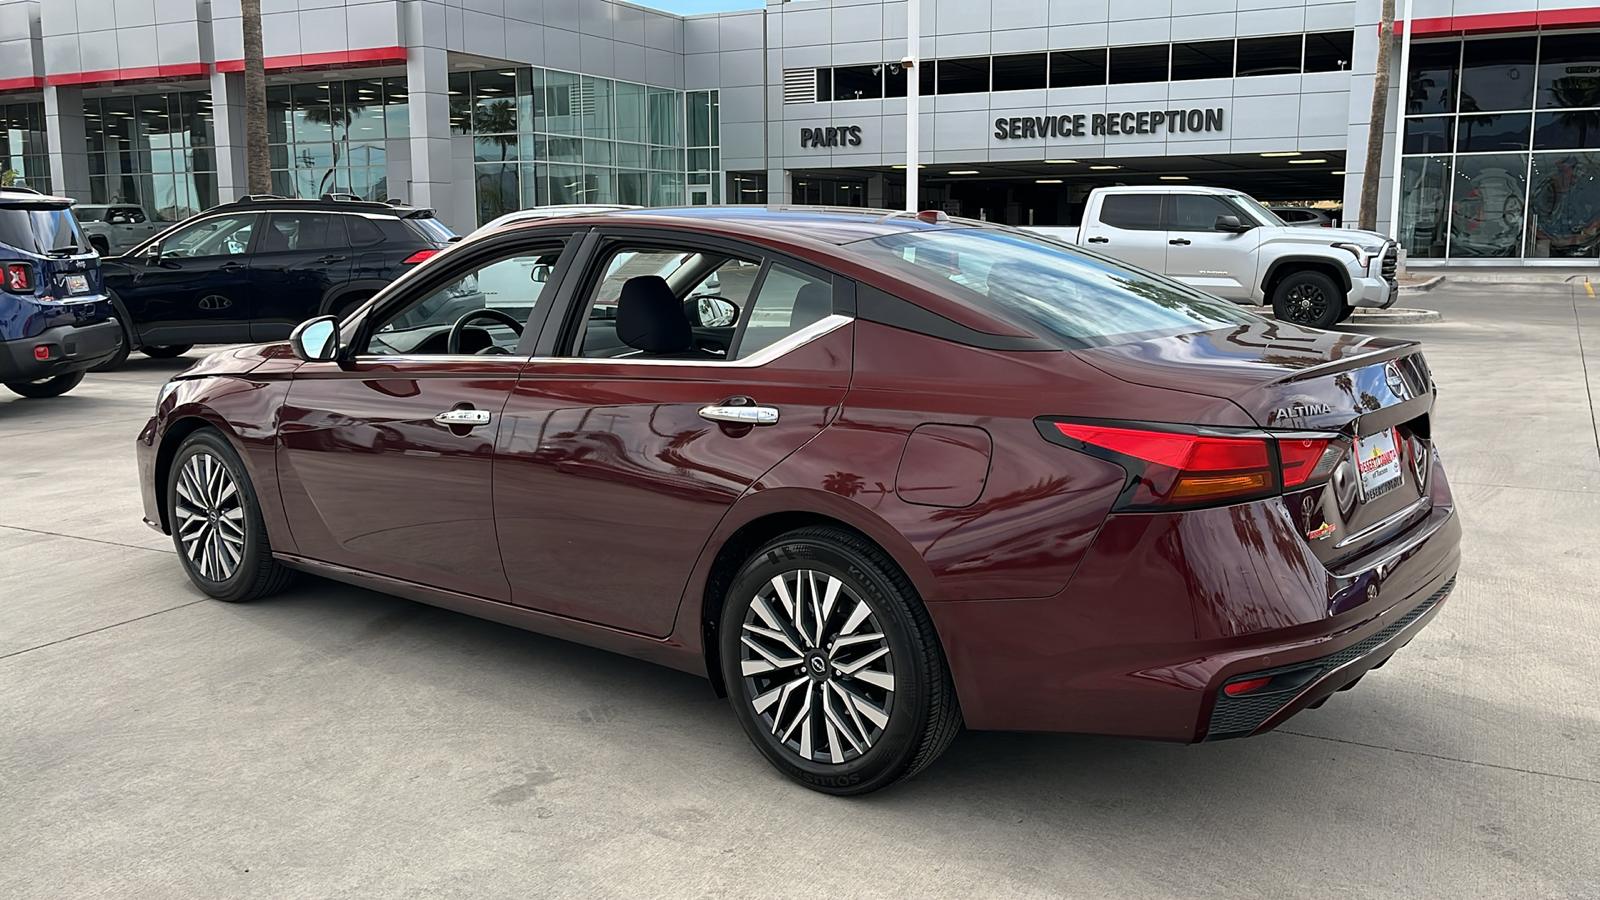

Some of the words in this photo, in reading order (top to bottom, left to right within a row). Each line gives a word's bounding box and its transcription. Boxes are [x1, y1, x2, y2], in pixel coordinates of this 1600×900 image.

[994, 114, 1086, 140] SERVICE
[1091, 108, 1223, 136] RECEPTION
[800, 125, 862, 148] PARTS
[1276, 403, 1331, 419] ALTIMA
[802, 772, 861, 787] SOLUS
